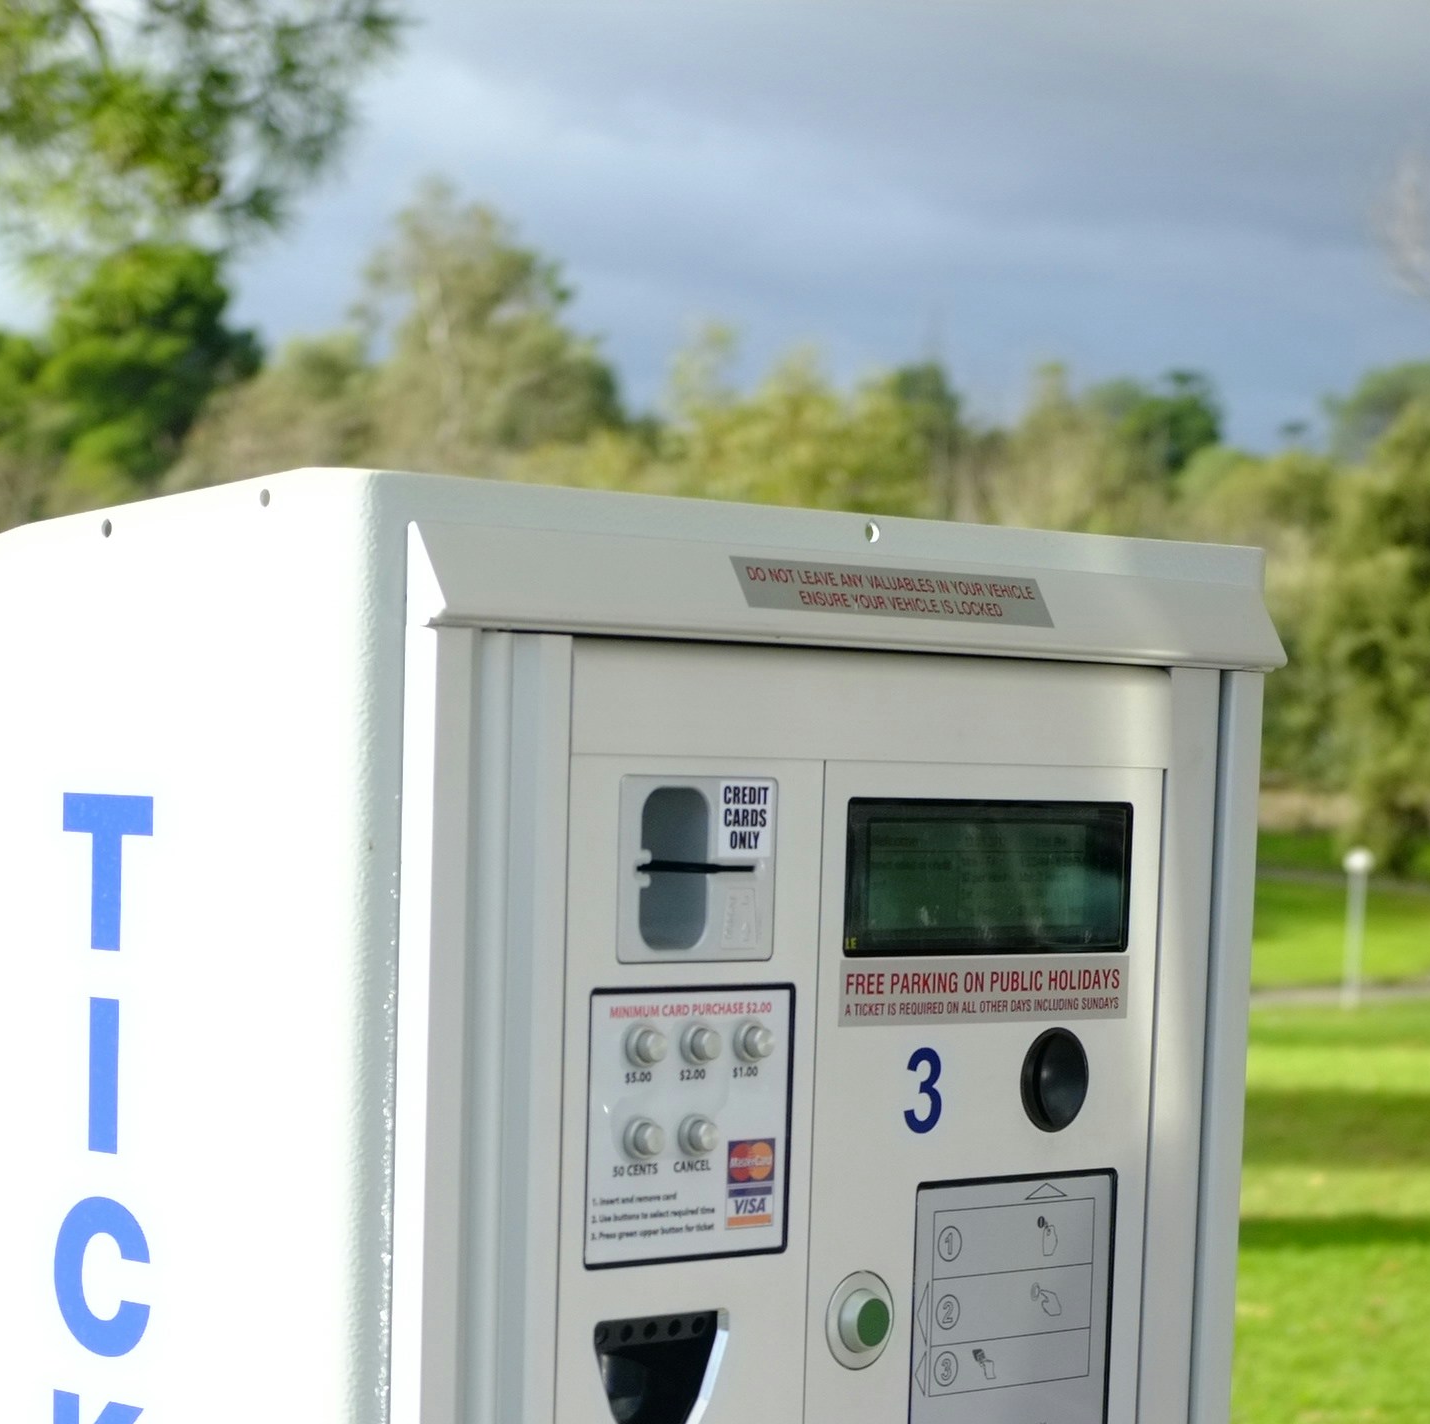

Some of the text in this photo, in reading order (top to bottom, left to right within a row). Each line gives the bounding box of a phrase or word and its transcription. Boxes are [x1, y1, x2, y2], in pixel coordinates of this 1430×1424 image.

[746, 566, 1035, 600] DO NOT LEAVE ANY VALUABLES IN YOUR VEHICLE
[799, 591, 1002, 617] ENSURE YOUR VEHICLE IS LOCKED
[724, 786, 769, 804] CREDIT
[724, 808, 766, 827] CARDS
[730, 831, 760, 849] ONLY
[846, 969, 1120, 995] FREE PARKING ON PUBLIC HOLIDAYS
[610, 1002, 772, 1018] MINIMUM CARD PURCHASE $2.00
[845, 997, 1119, 1016] A TICKET IS REQUIRED ON ALL OTHER DAYS INCLUDING SUNDAYS
[625, 1066, 758, 1083] $5.00 $2.00 $1.00
[904, 1047, 941, 1134] 3
[613, 1160, 711, 1177] 50 CENTS CANCEL
[734, 1198, 766, 1214] VISA
[945, 1232, 953, 1255] 1
[942, 1301, 953, 1324] 2
[941, 1358, 952, 1380] 3
